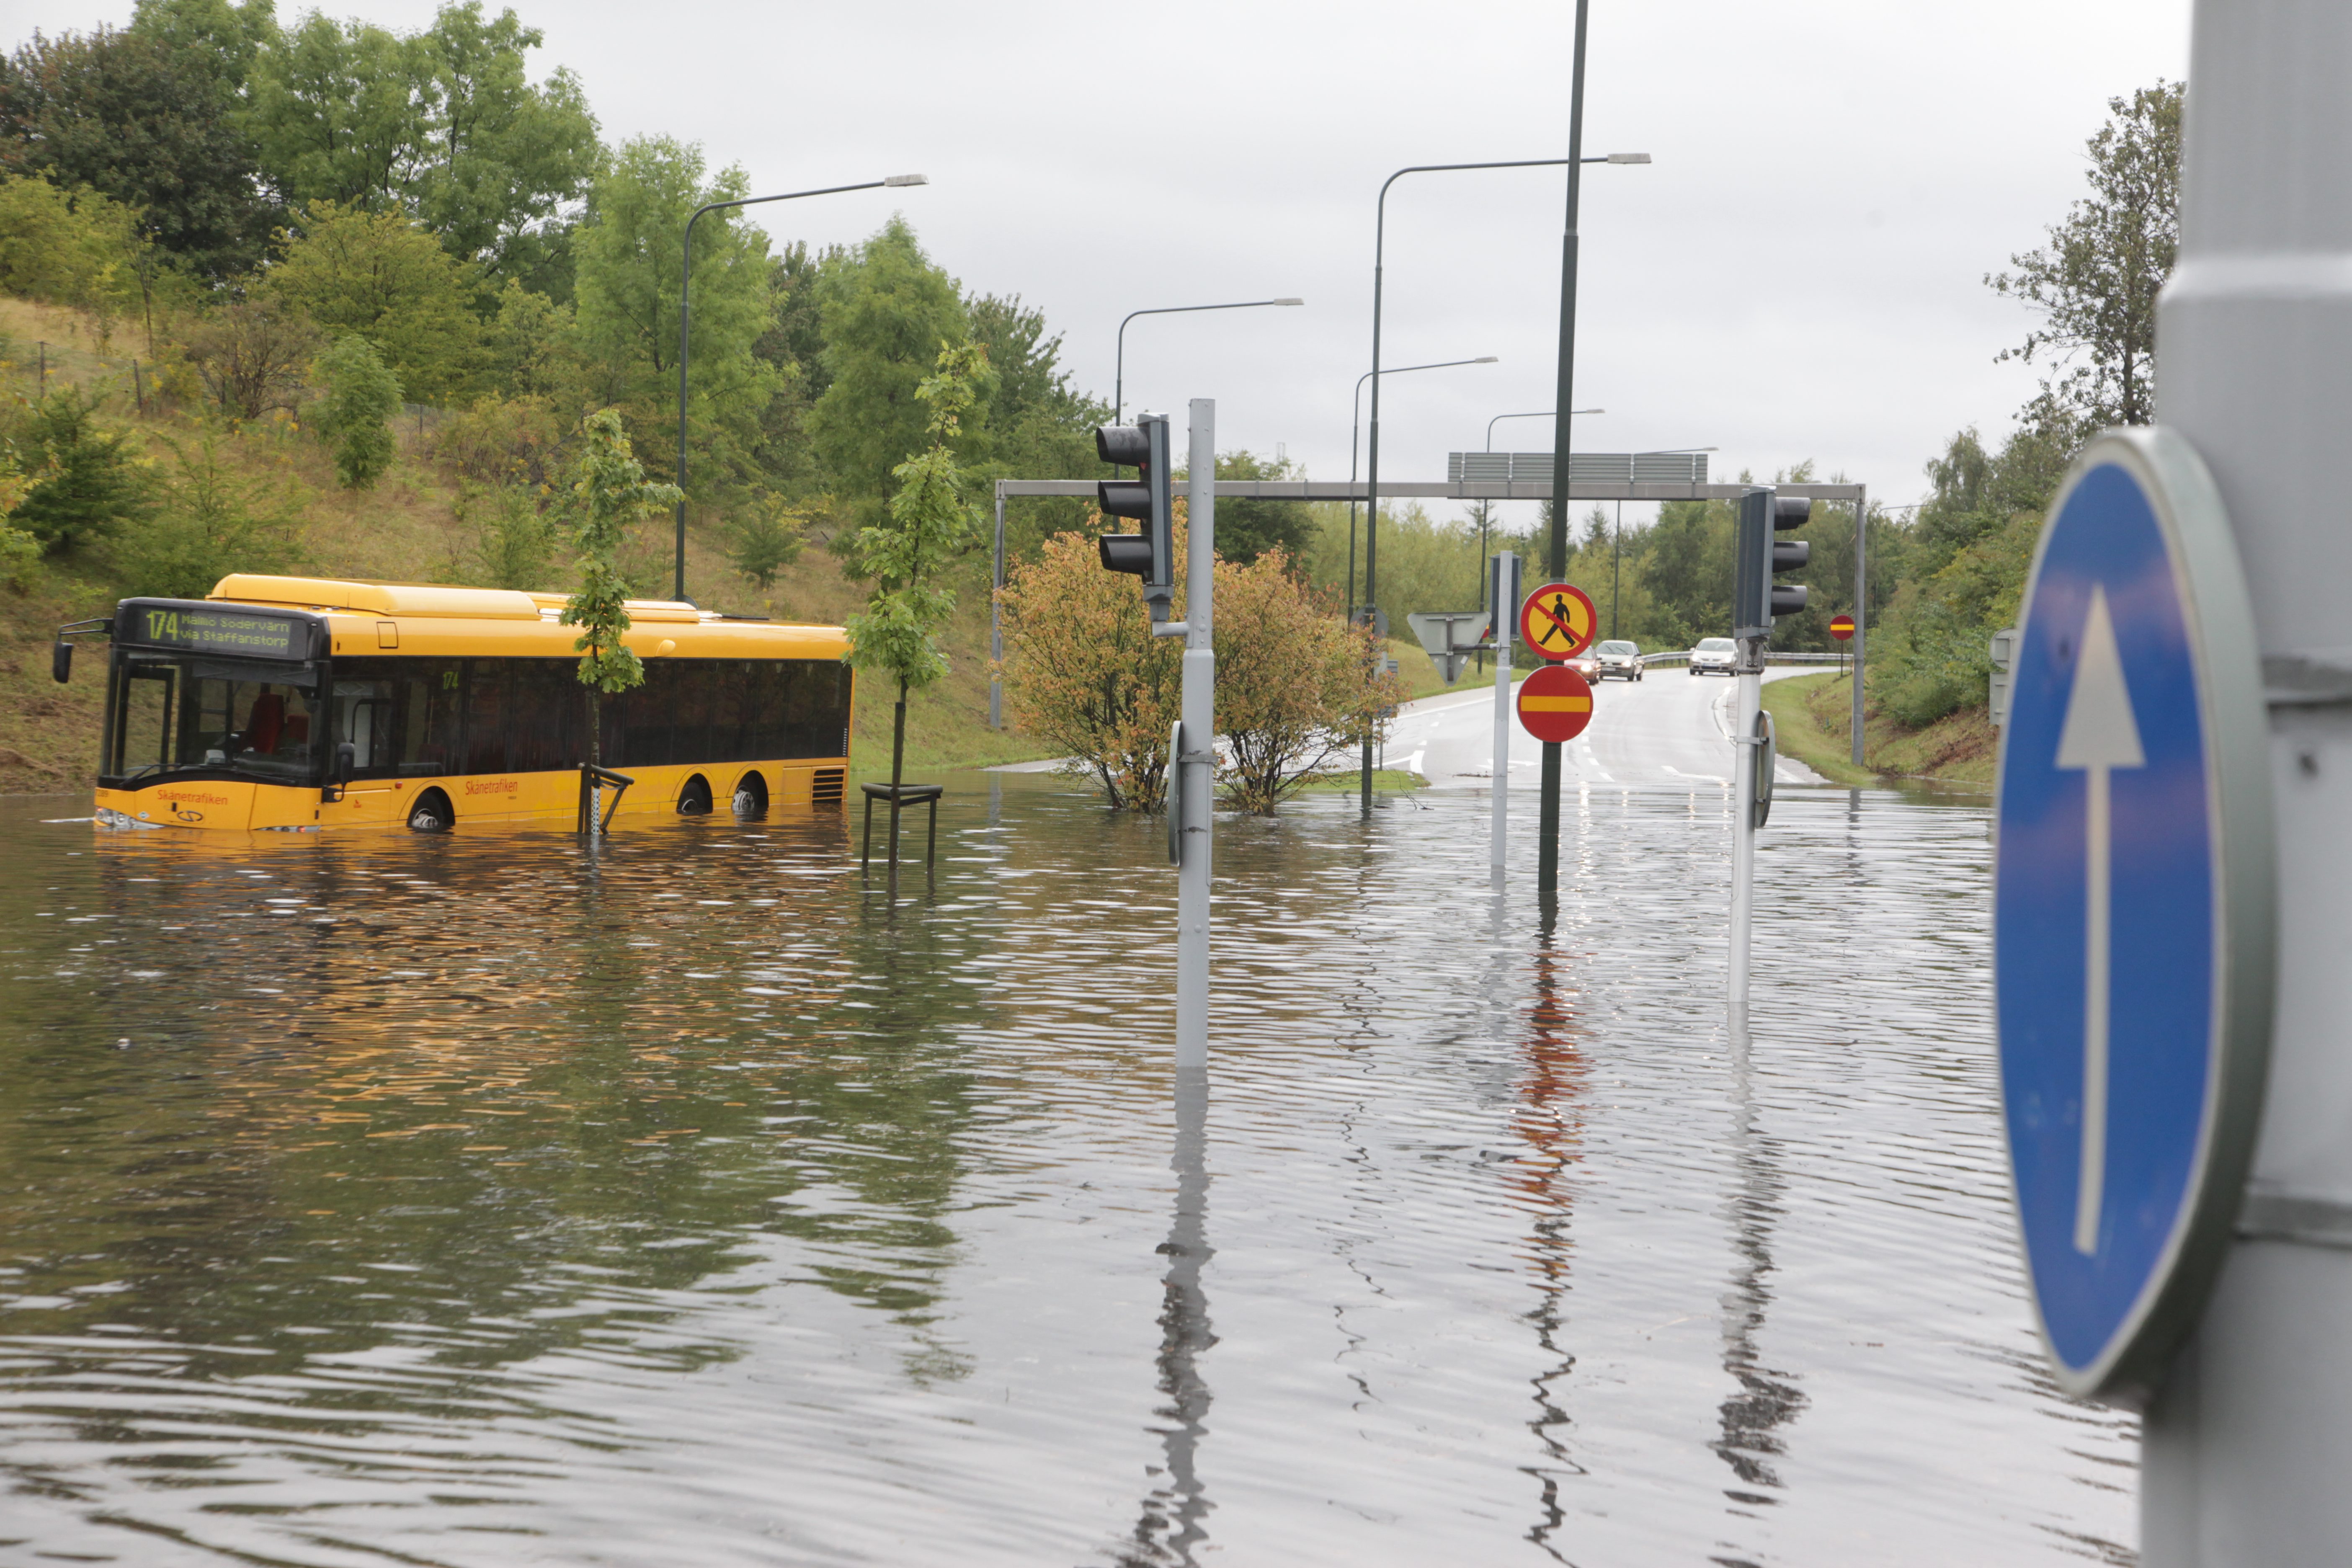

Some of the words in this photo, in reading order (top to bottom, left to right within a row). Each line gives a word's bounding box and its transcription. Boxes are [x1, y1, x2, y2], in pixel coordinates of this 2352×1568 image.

[146, 610, 178, 641] 174
[181, 614, 216, 626] Malmö
[180, 629, 199, 640] via
[203, 630, 289, 648] Staffanstorp
[443, 671, 458, 689] 174
[465, 778, 518, 795] Skånetrafiken
[157, 789, 228, 805] Skånetrafiken
